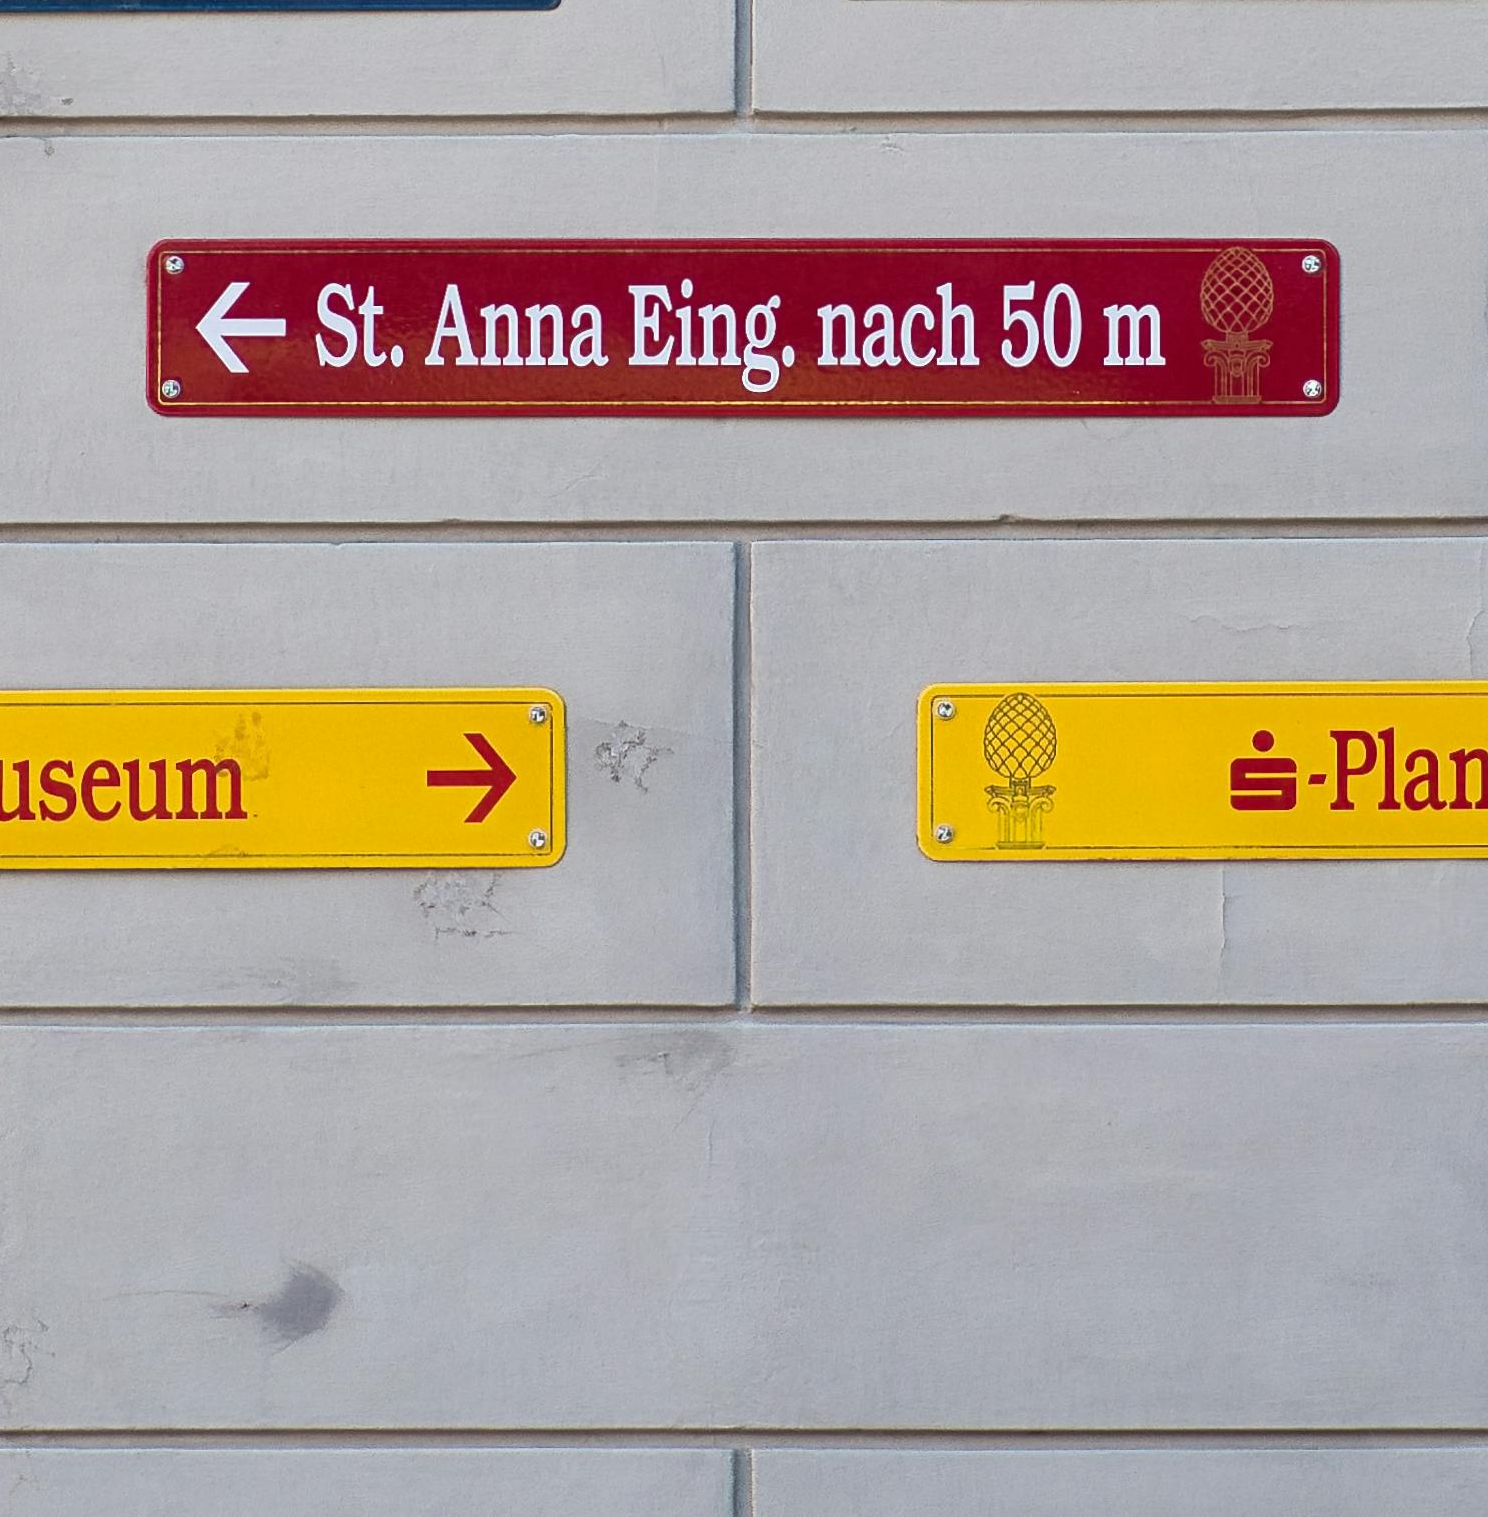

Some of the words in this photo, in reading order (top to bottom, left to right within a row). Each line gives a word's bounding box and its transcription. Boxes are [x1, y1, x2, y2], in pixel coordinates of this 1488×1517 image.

[315, 282, 404, 368] St.
[424, 283, 610, 367] Anna
[628, 278, 795, 393] Eing.
[817, 282, 980, 368] nach
[1001, 280, 1082, 368] 50
[1103, 304, 1166, 366] m
